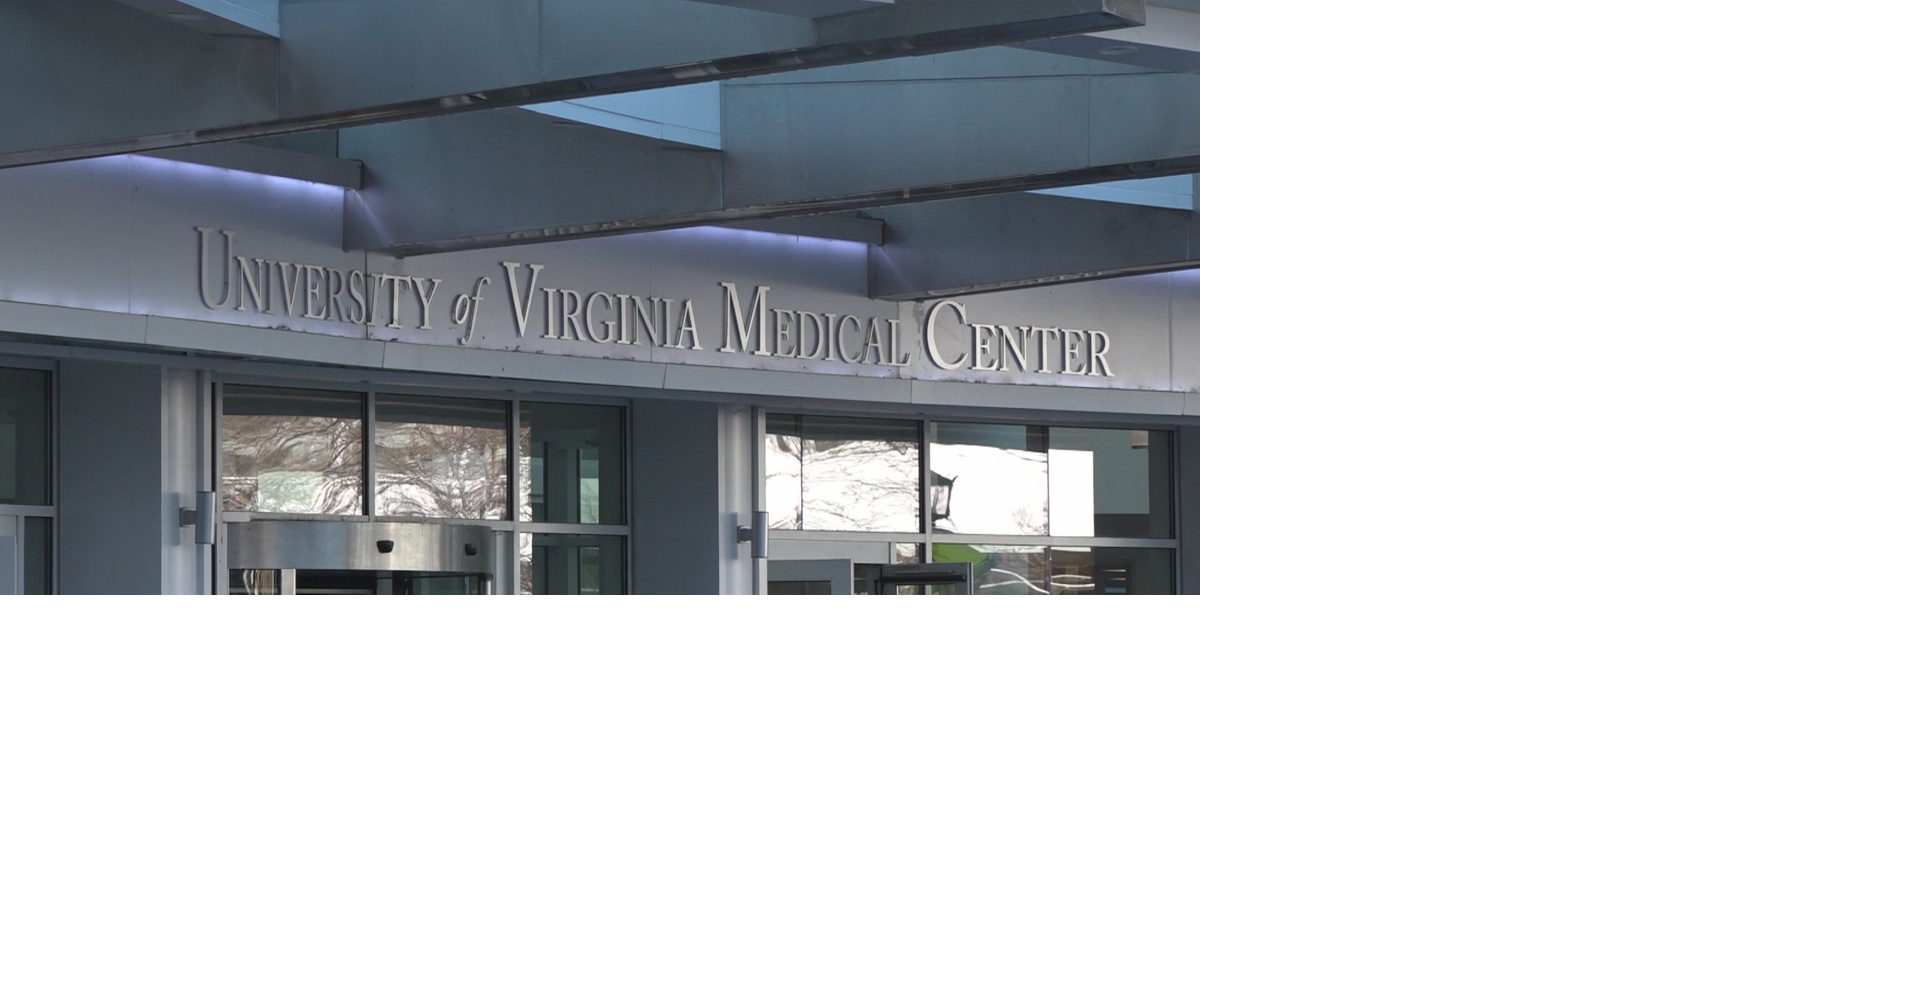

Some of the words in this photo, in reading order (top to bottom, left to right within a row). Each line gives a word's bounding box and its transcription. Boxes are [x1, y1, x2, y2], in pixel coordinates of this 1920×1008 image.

[195, 226, 442, 330] UNIVERSITY
[451, 276, 491, 345] of
[502, 261, 703, 351] VIRGINIA
[718, 281, 911, 367] MEDICAL
[926, 300, 1115, 377] CENTER
